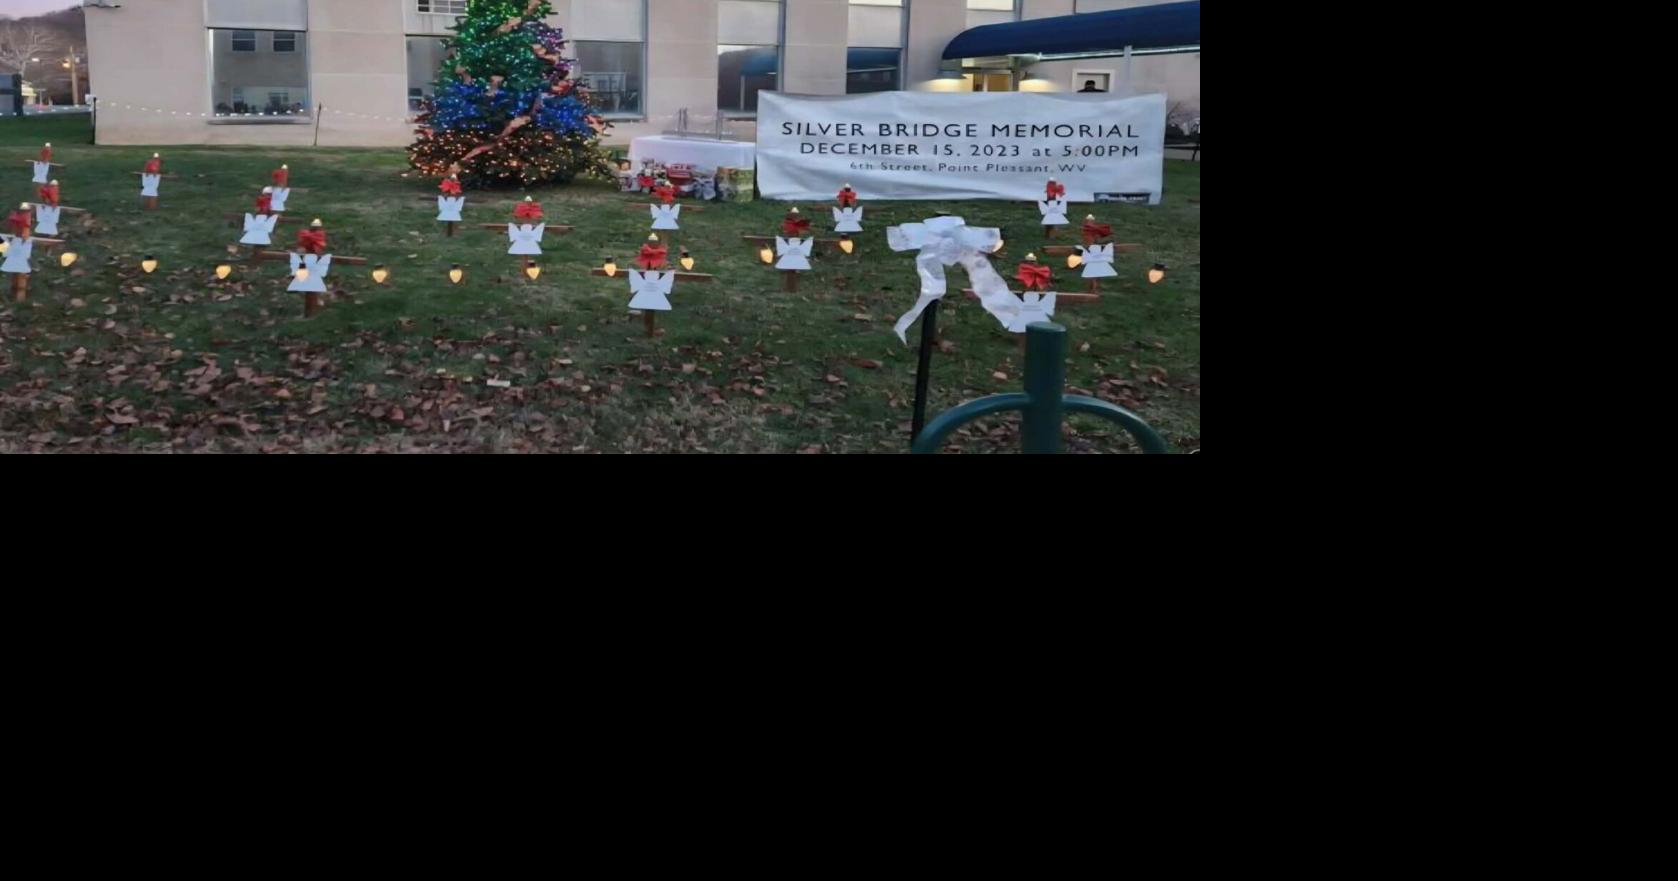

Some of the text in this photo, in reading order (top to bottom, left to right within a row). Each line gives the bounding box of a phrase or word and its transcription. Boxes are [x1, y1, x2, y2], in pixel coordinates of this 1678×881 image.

[781, 121, 1140, 138] SILVER BRIDGE MEMORIAL
[800, 142, 920, 155] DECEMBER
[969, 144, 1020, 157] 2023
[1032, 147, 1052, 157] at
[1062, 145, 1139, 157] 5:00PM
[850, 162, 873, 171] 6th
[938, 162, 979, 172] Point
[1058, 164, 1087, 173] WV
